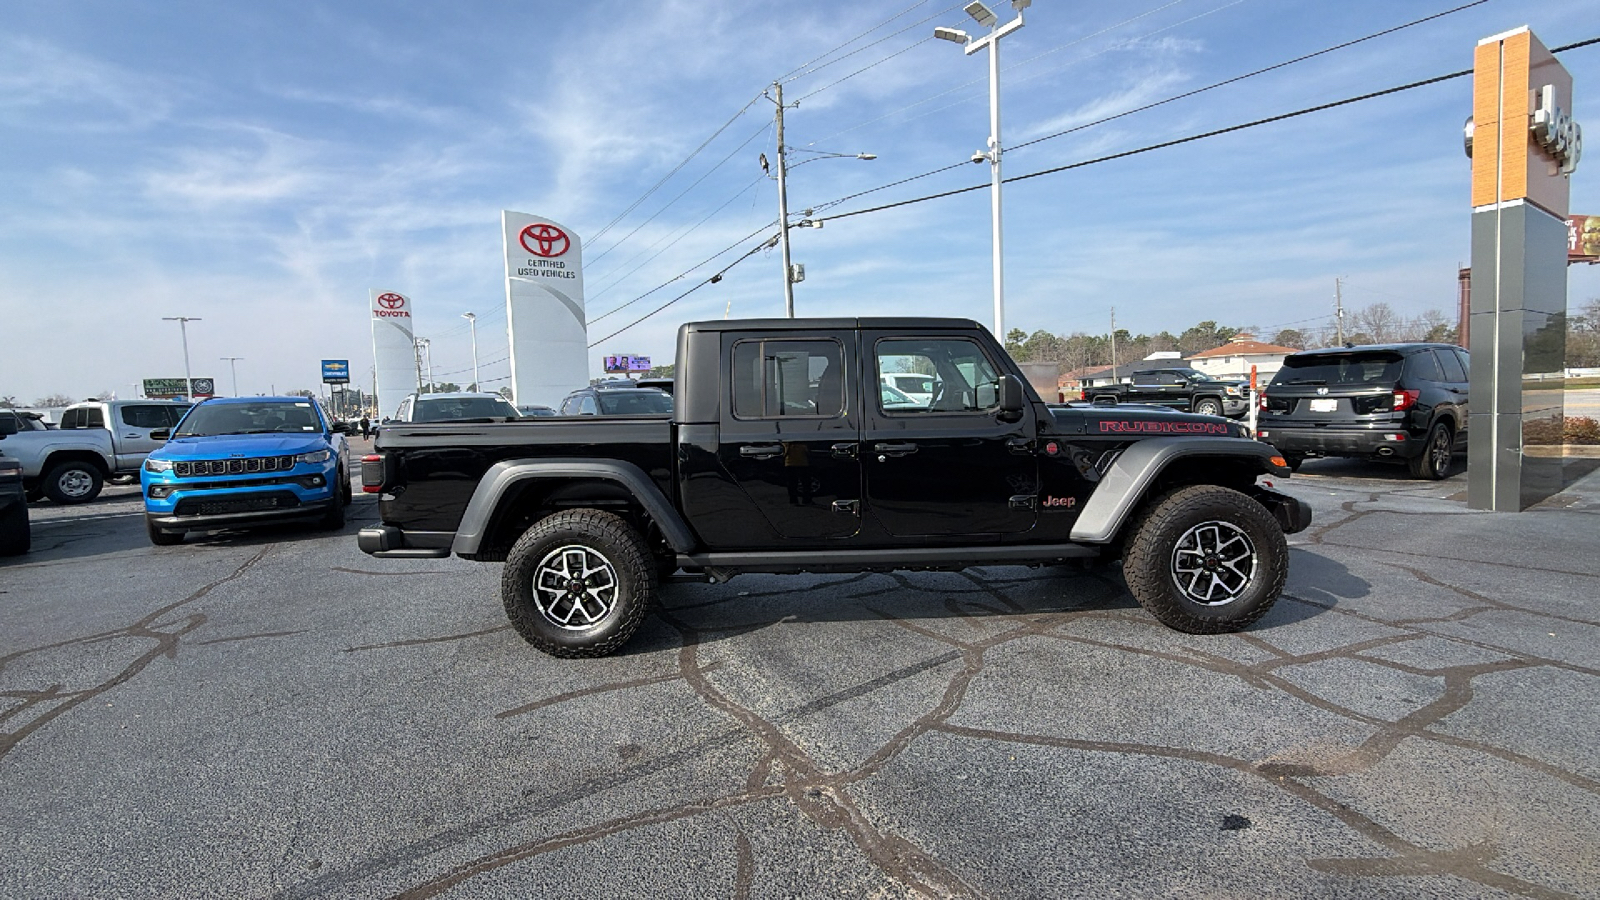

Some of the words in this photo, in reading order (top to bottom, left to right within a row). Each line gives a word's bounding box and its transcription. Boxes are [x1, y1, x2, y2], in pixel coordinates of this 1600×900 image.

[527, 259, 566, 269] CERTIFIED
[517, 267, 539, 277] USED
[541, 269, 576, 279] VEHICLES
[373, 310, 411, 318] TOYOTA
[1099, 421, 1228, 434] RUBICON
[1042, 495, 1076, 508] Jeep
